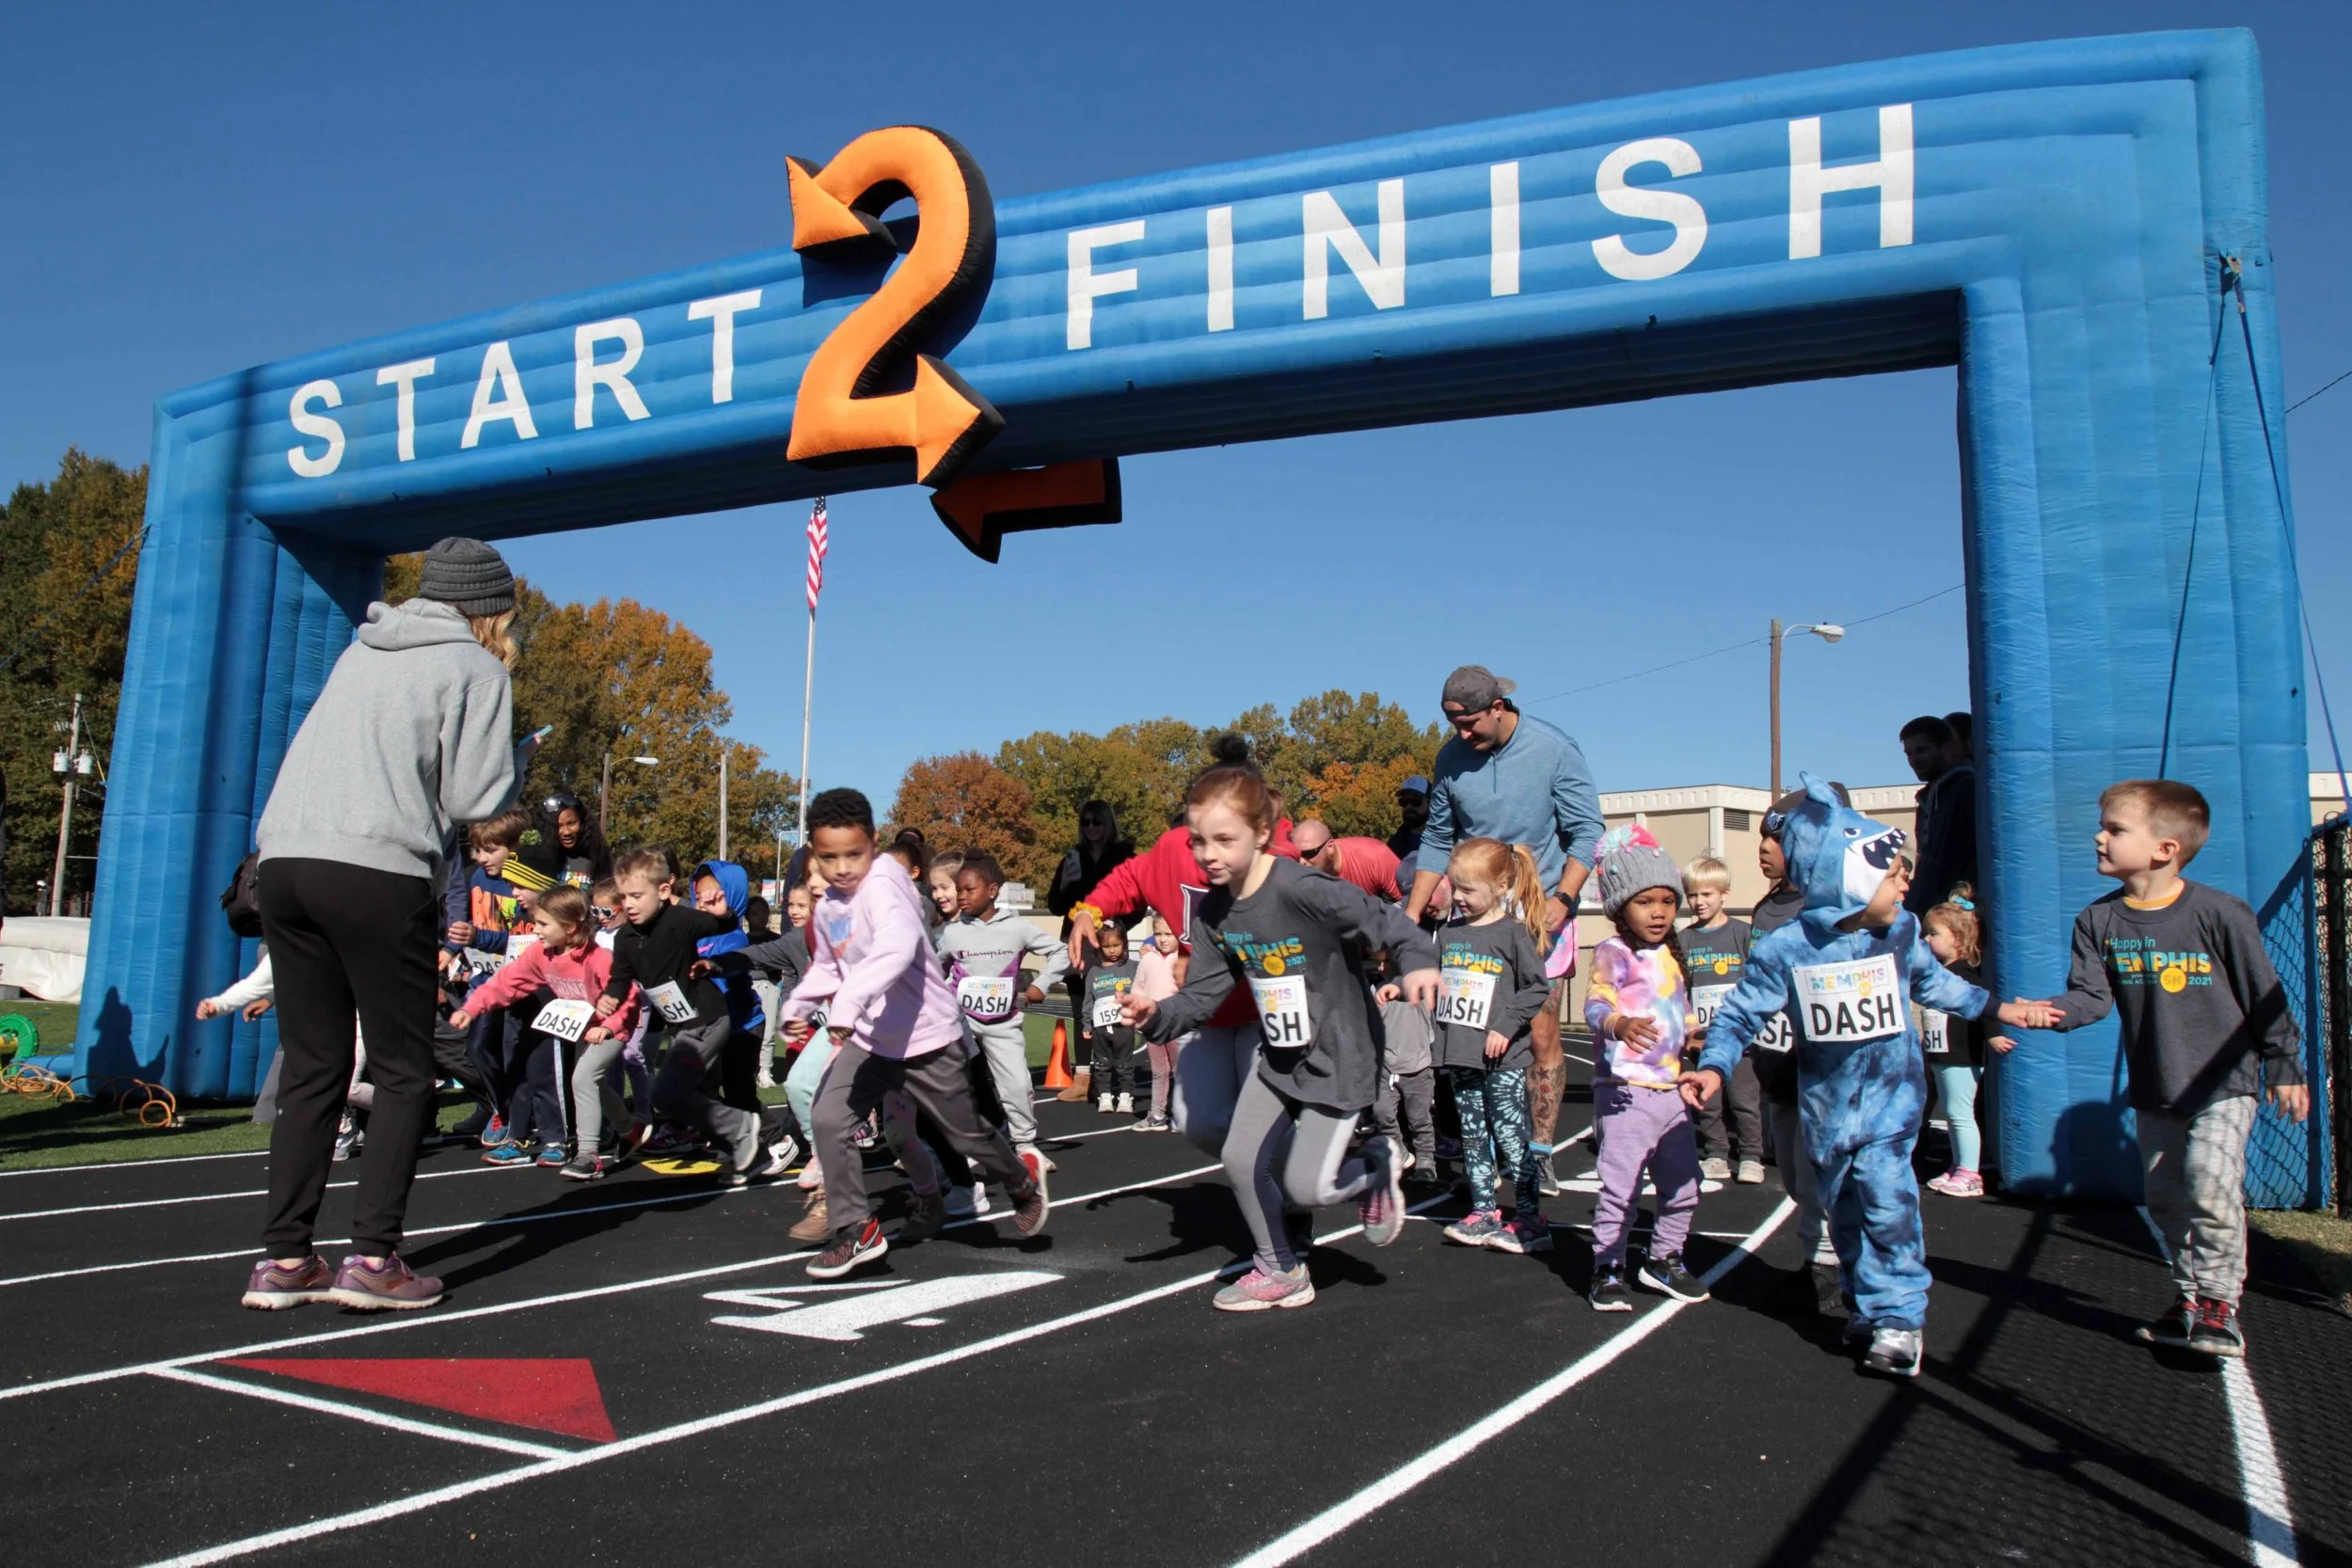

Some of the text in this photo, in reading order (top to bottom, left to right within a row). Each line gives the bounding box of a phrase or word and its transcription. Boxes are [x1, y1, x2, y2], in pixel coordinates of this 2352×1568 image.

[288, 103, 1914, 485] START 2 FINISH
[2109, 936, 2155, 950] Happy in
[957, 949, 1013, 958] Champion
[1285, 955, 1307, 966] 2021
[2113, 951, 2212, 974] EMPHIS
[473, 960, 501, 973] DAS
[1810, 968, 1884, 990] MEMPHIS
[2188, 976, 2212, 986] 2021
[664, 1001, 690, 1021] SH
[961, 994, 1008, 1013] DASH
[1438, 996, 1484, 1023] DASH
[538, 1011, 582, 1037] DASH
[1697, 1006, 1715, 1024] DA
[1810, 993, 1897, 1036] DASH
[1264, 1012, 1302, 1041] SH
[1754, 1017, 1793, 1047] SH
[1924, 1030, 1942, 1049] SH
